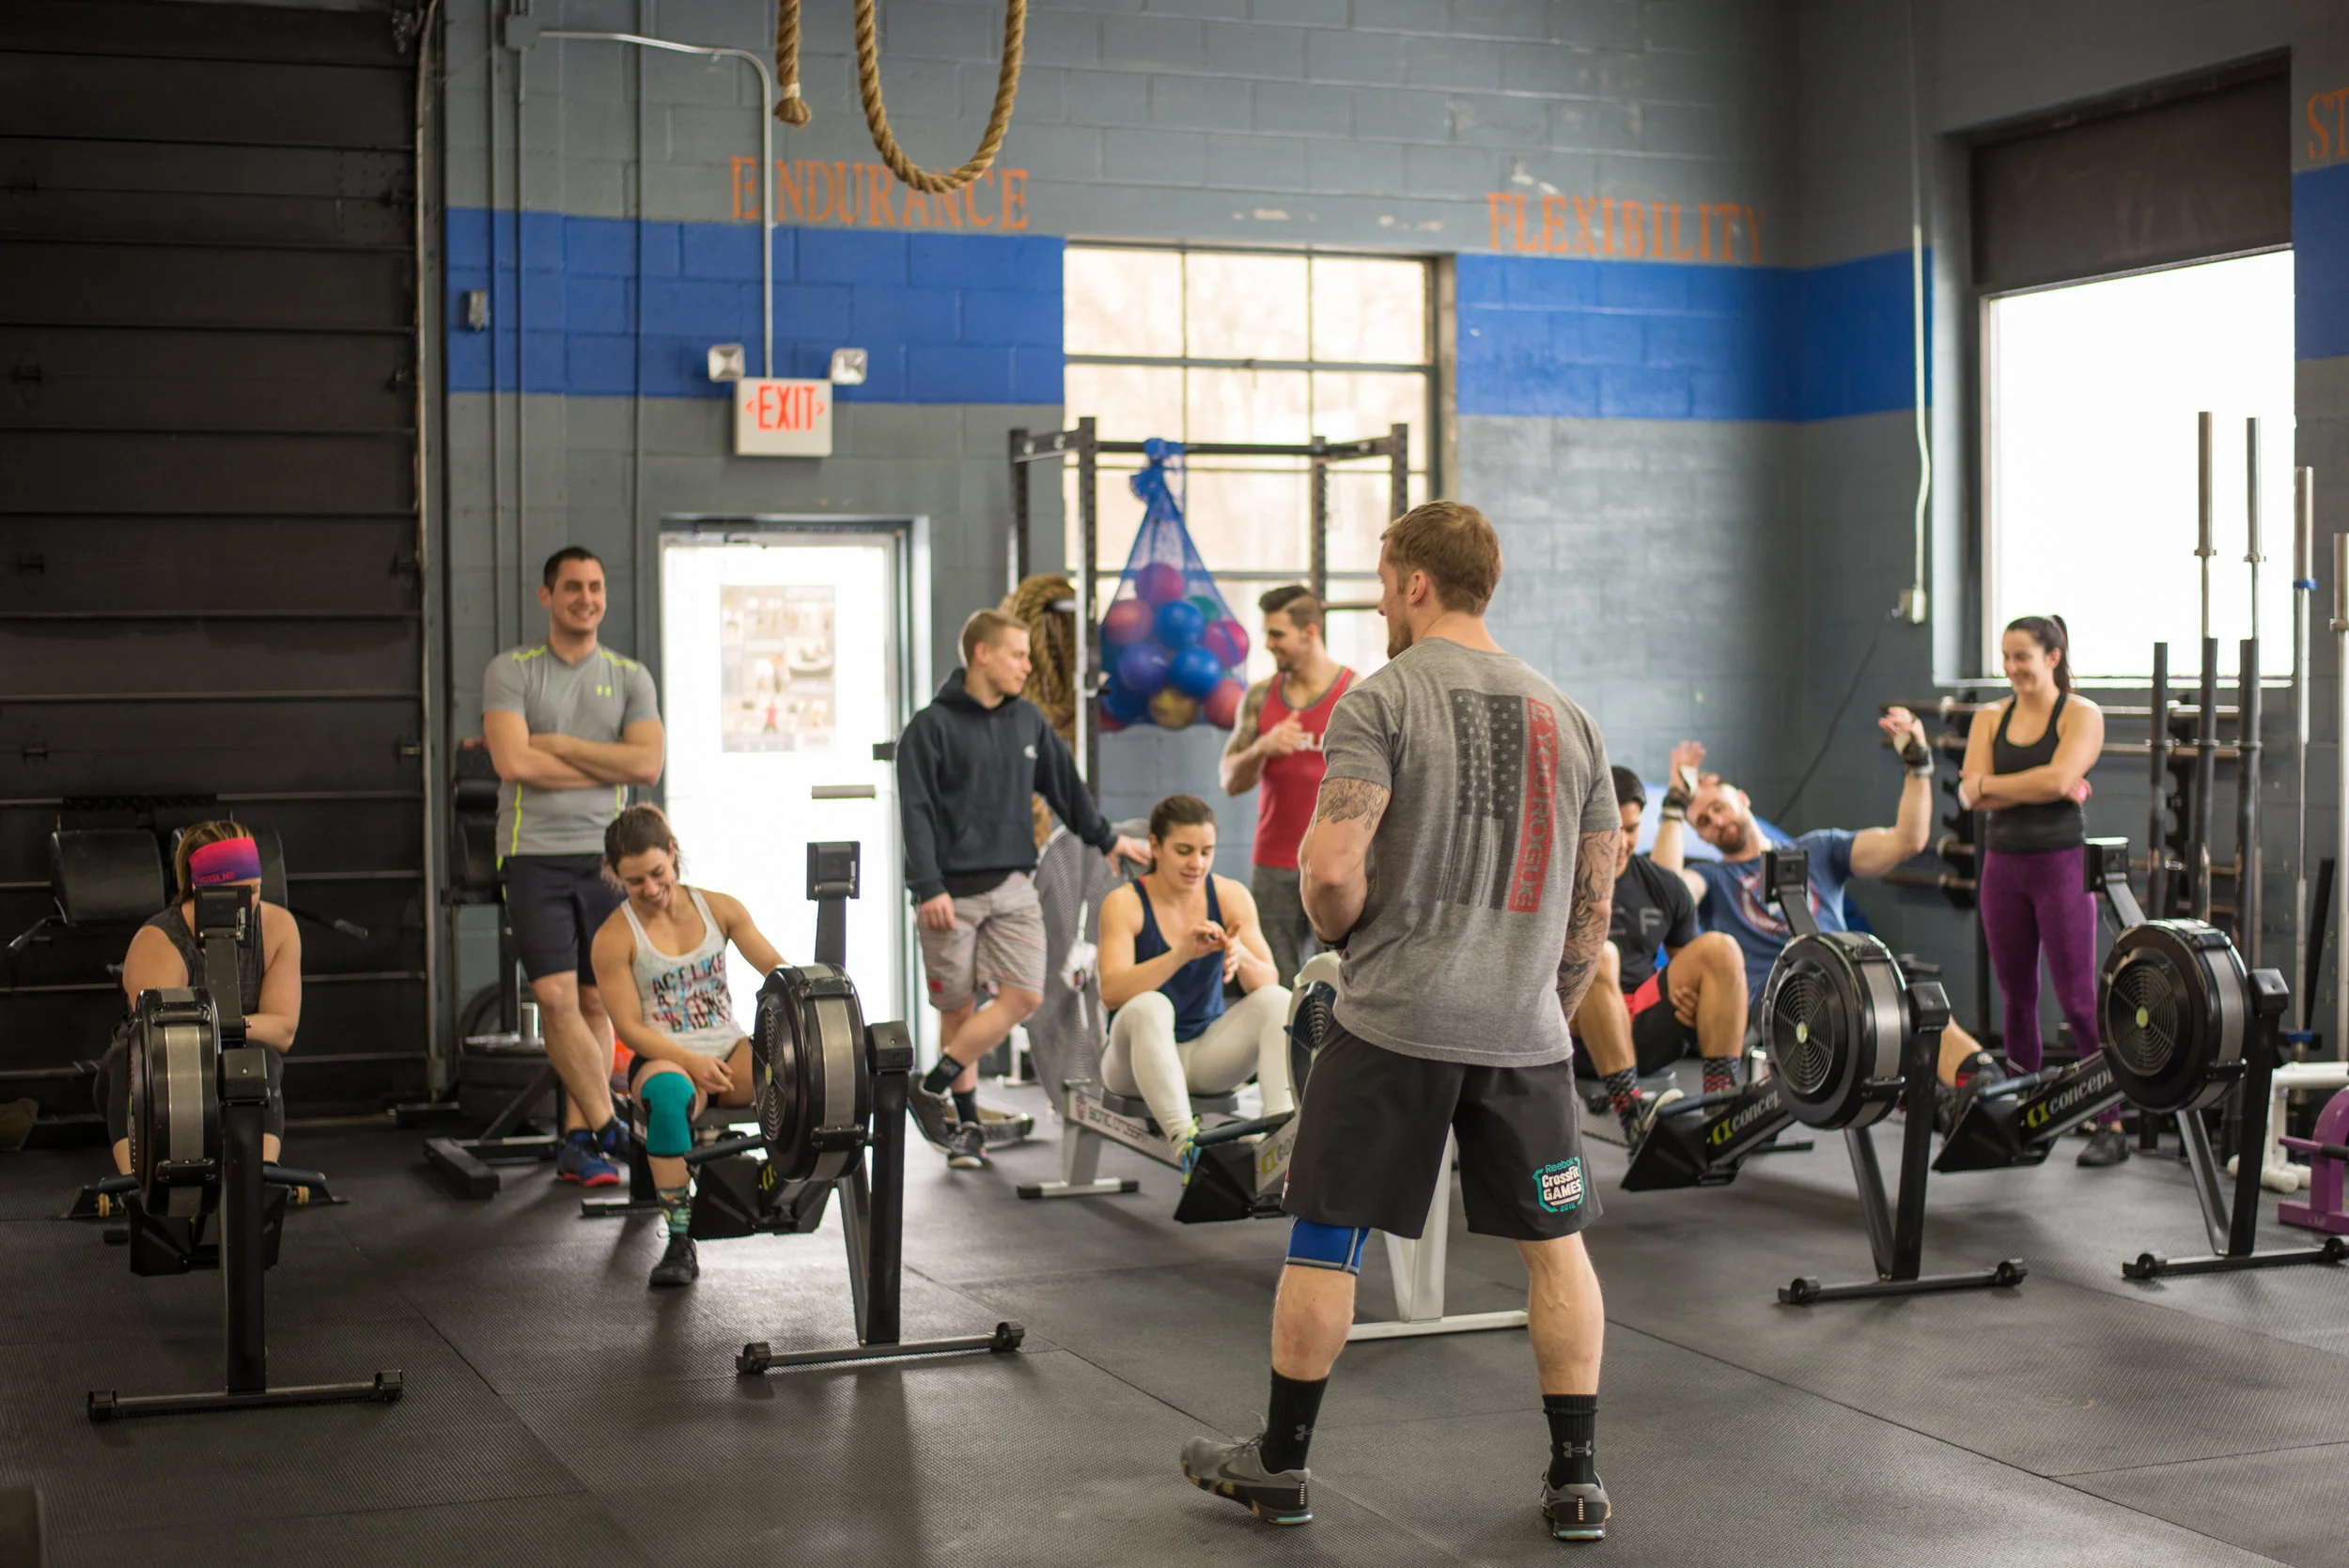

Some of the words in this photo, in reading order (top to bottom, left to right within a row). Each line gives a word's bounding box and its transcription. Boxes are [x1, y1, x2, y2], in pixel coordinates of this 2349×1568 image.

[729, 156, 1030, 230] ENDURANCE
[1486, 193, 1766, 263] FLEXIBILITY
[757, 384, 818, 431] EXIT
[1515, 798, 1551, 907] ROGUE
[1542, 1166, 1579, 1188] CrossFit
[1546, 1157, 1574, 1172] Reebok
[1543, 1180, 1581, 1202] GAMES
[1560, 1203, 1576, 1212] 2016
